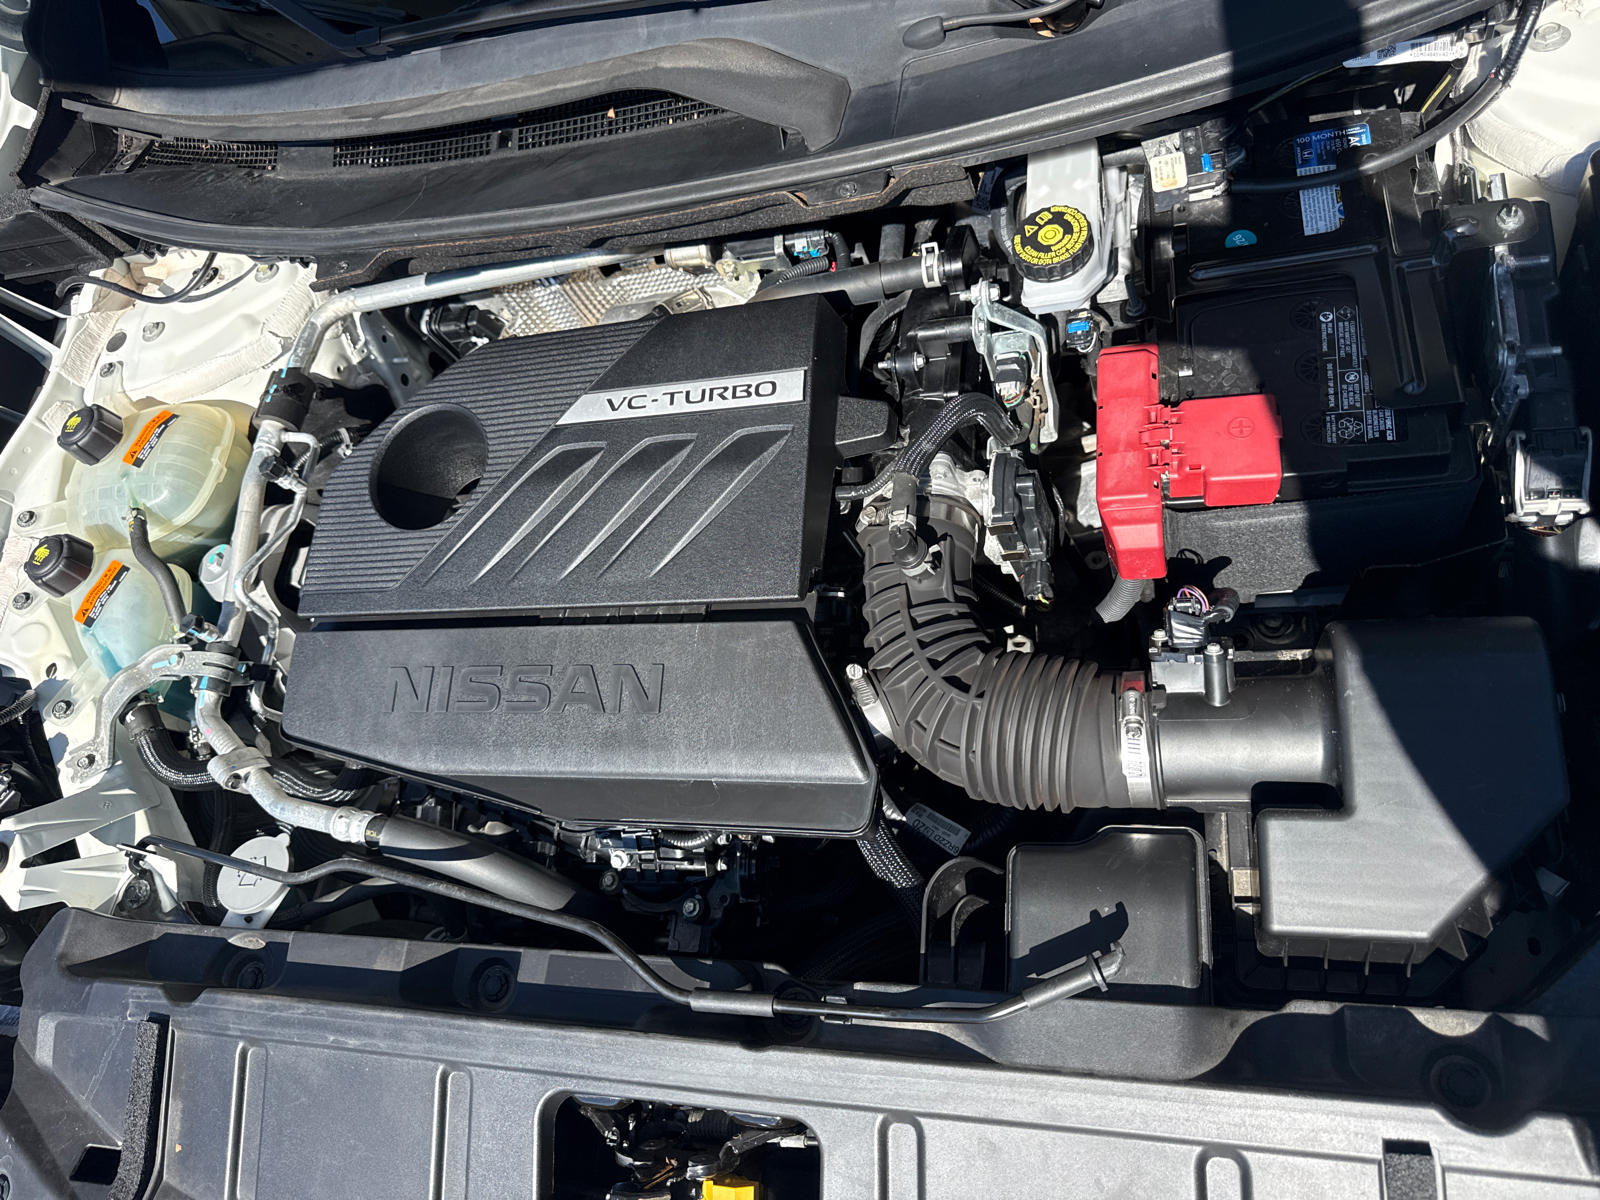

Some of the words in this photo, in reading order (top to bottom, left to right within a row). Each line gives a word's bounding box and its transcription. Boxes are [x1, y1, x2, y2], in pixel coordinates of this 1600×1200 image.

[1312, 130, 1345, 141] MONTH
[1052, 251, 1069, 262] BRAKE
[1055, 246, 1066, 256] CAP
[606, 380, 778, 412] VC-TURBO
[86, 580, 103, 602] WARNING
[90, 567, 117, 605] AVERTISSEMENT
[382, 663, 664, 714] NISSAN
[912, 819, 926, 830] ZD
[934, 834, 960, 854] 6RZ2D
